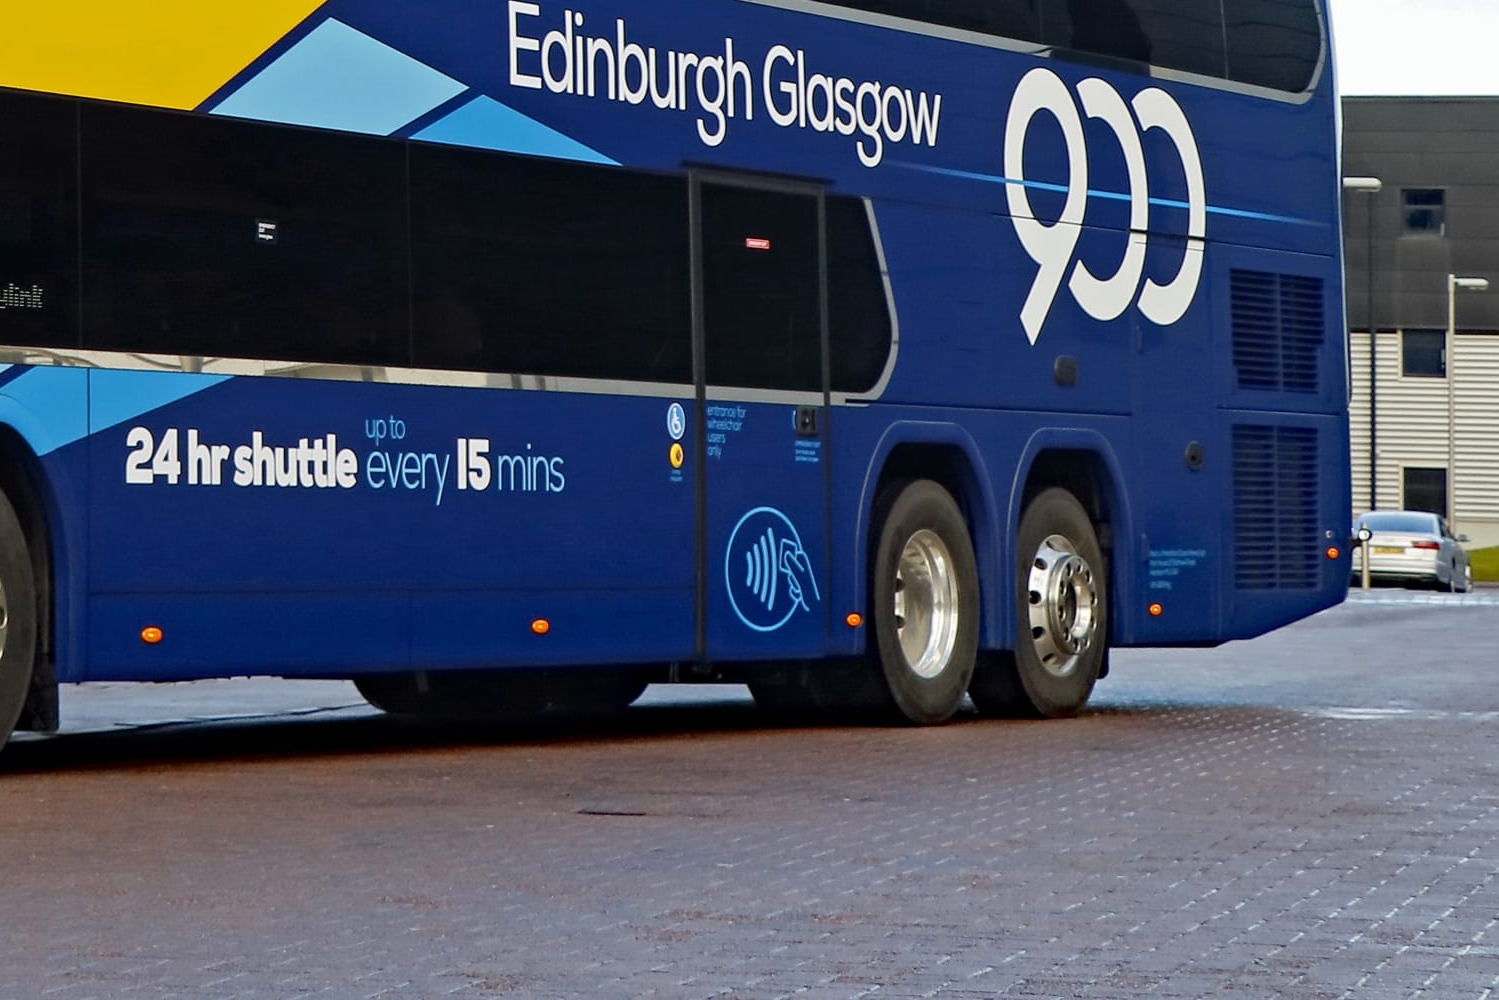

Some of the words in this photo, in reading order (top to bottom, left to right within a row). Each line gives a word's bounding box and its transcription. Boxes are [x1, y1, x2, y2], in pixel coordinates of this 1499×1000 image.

[508, 0, 753, 147] Edinburgh
[762, 44, 942, 168] Glasgow
[1004, 67, 1206, 346] 900
[125, 427, 181, 485] 24
[187, 429, 229, 486] hr
[233, 431, 358, 488] shuttle
[366, 448, 450, 506] every
[457, 437, 491, 491] 15
[497, 443, 565, 492] mins
[365, 418, 387, 445] up
[388, 416, 406, 440] to
